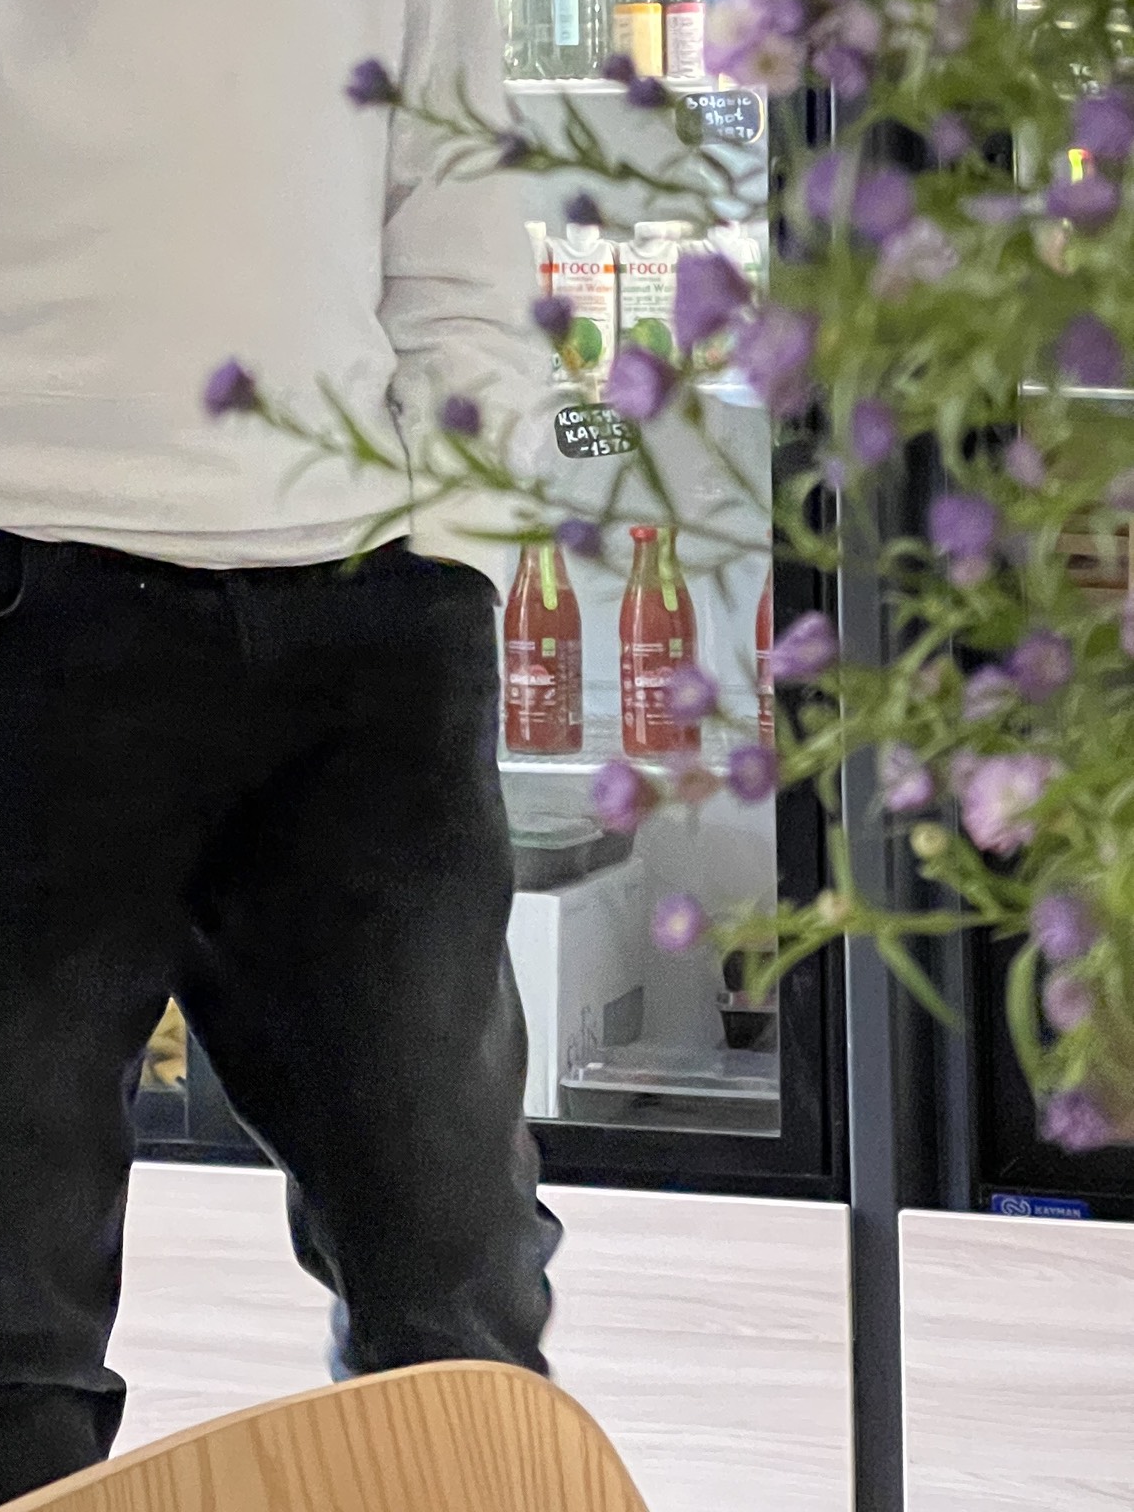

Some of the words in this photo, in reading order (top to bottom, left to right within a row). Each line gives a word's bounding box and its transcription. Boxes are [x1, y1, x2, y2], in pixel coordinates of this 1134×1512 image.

[561, 262, 601, 275] FOCO
[629, 262, 669, 275] FOCO
[1033, 1205, 1081, 1219] KAYMAN
